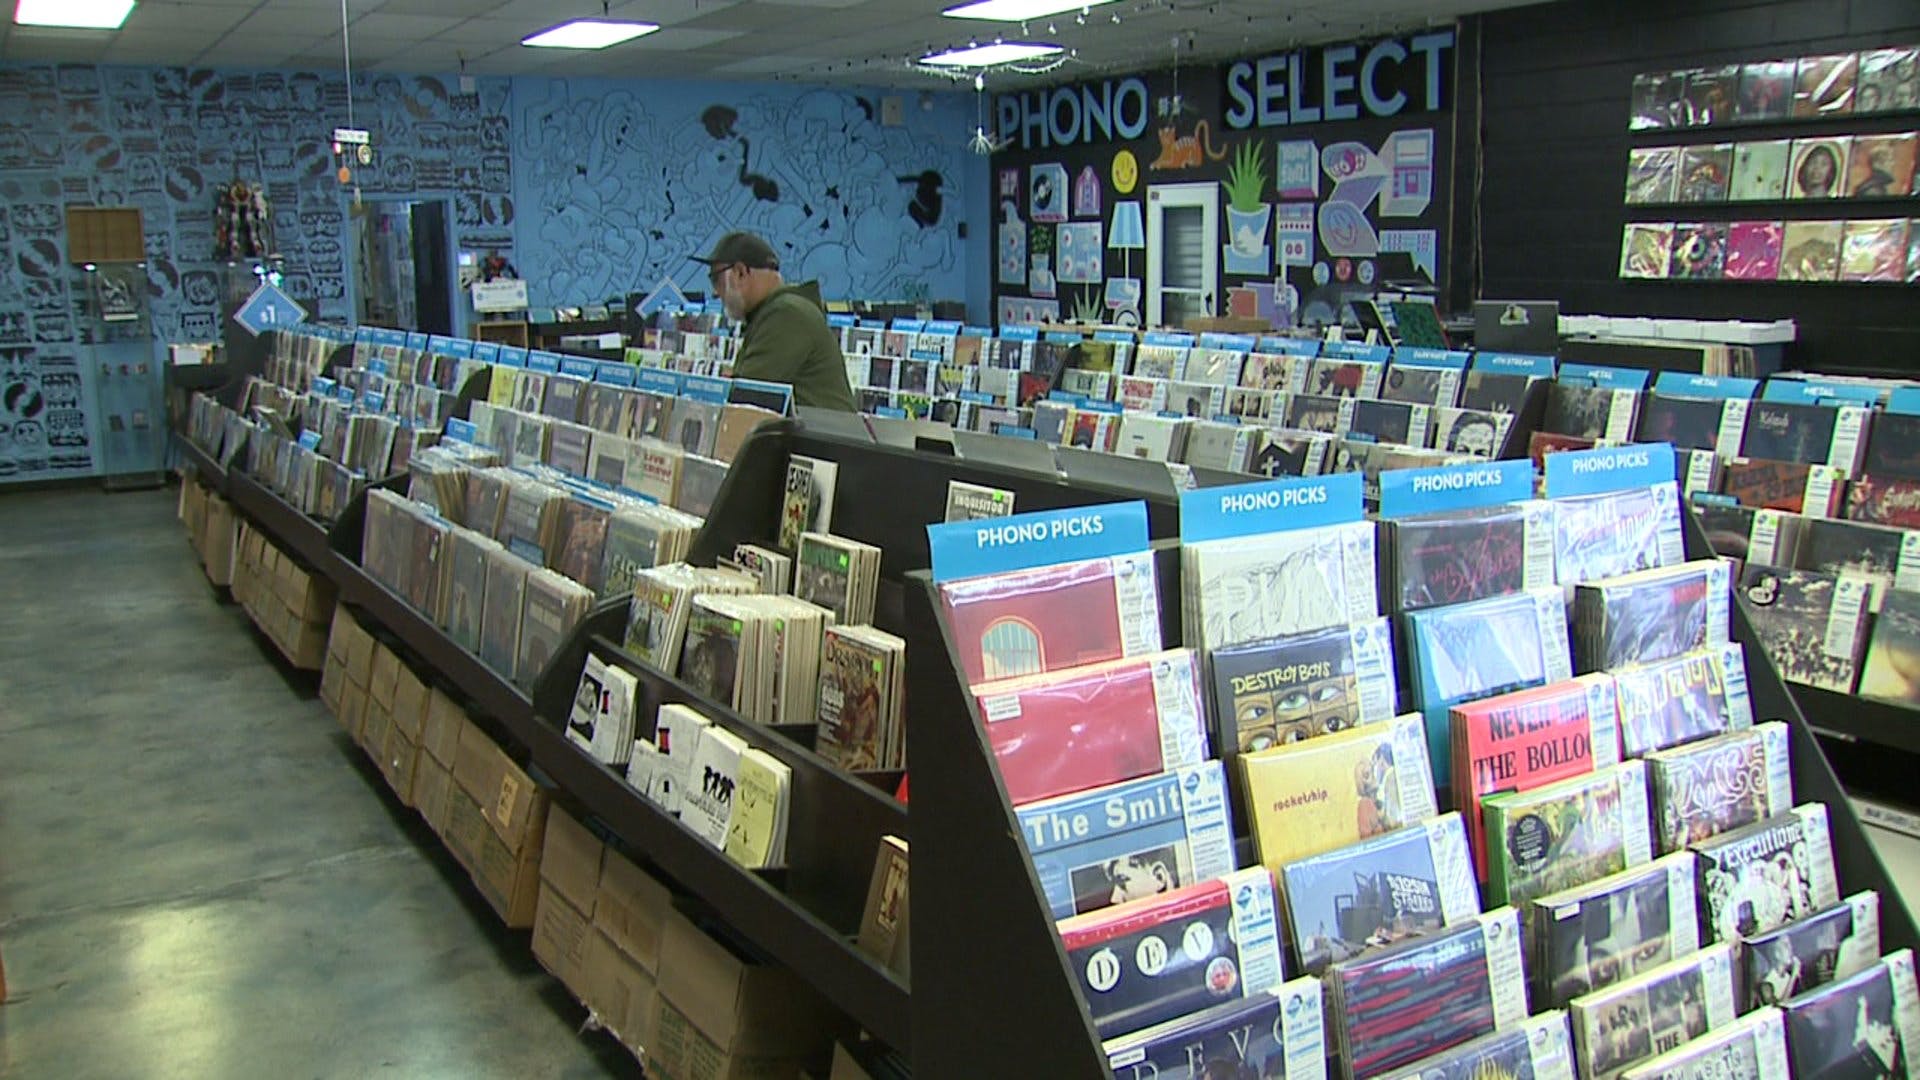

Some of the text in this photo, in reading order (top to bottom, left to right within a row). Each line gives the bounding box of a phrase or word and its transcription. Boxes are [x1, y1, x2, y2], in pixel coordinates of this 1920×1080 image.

[999, 32, 1456, 149] PHONO SELECT
[1690, 377, 1719, 387] METAL
[1803, 386, 1835, 397] METAL
[1572, 451, 1648, 474] PHONO PICKS
[1413, 470, 1502, 493] PHONO PICKS
[1221, 485, 1326, 514] PHONO PICKS
[977, 515, 1103, 549] PHONO PICKS
[1231, 660, 1331, 693] DESTROY BOYS
[1489, 703, 1552, 741] NEVER
[1474, 751, 1517, 786] THE
[1273, 788, 1328, 812] rocketship
[1025, 790, 1182, 847] The Smit
